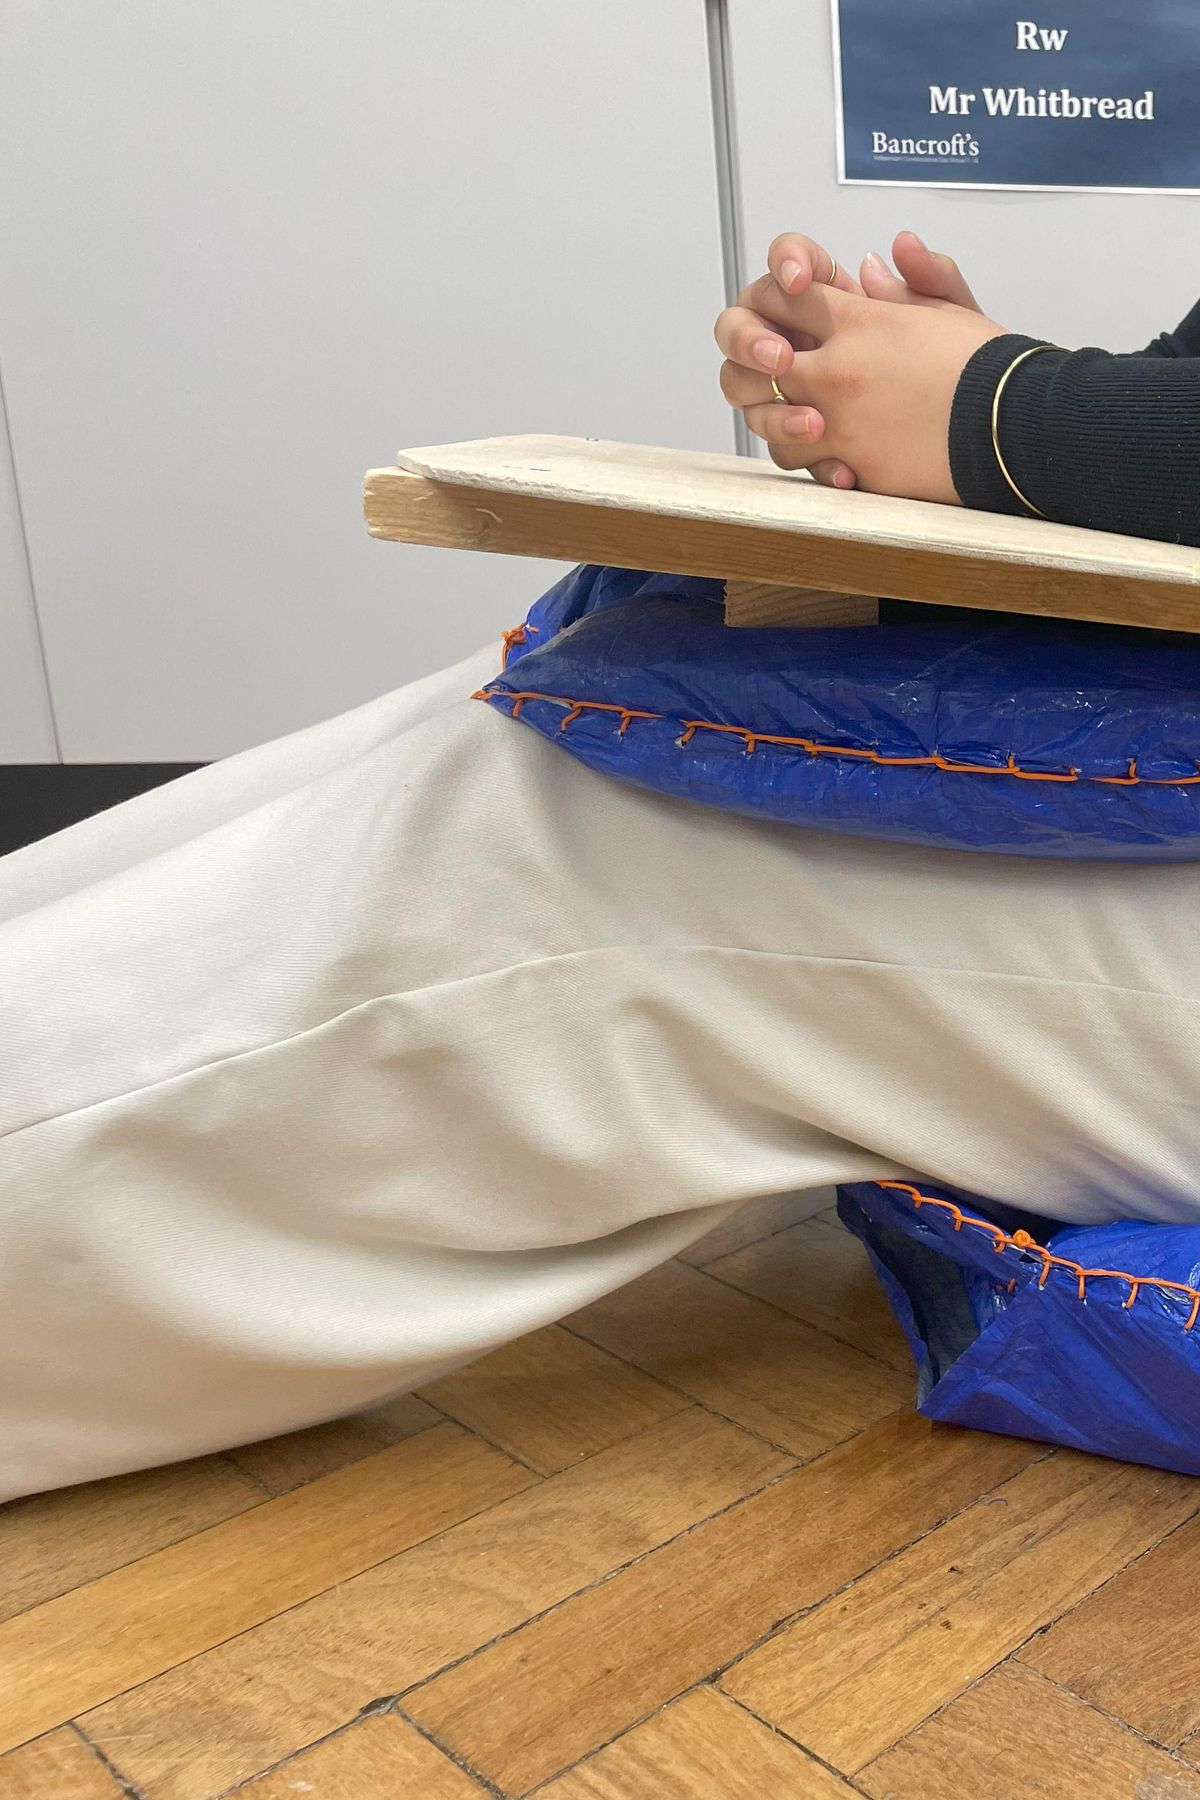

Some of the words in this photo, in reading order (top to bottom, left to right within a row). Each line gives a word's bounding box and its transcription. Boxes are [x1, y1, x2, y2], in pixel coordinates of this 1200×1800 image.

[1015, 21, 1069, 51] Rw
[928, 86, 976, 116] Mr
[982, 88, 1155, 120] Whitbread
[872, 131, 980, 156] Bancroft's
